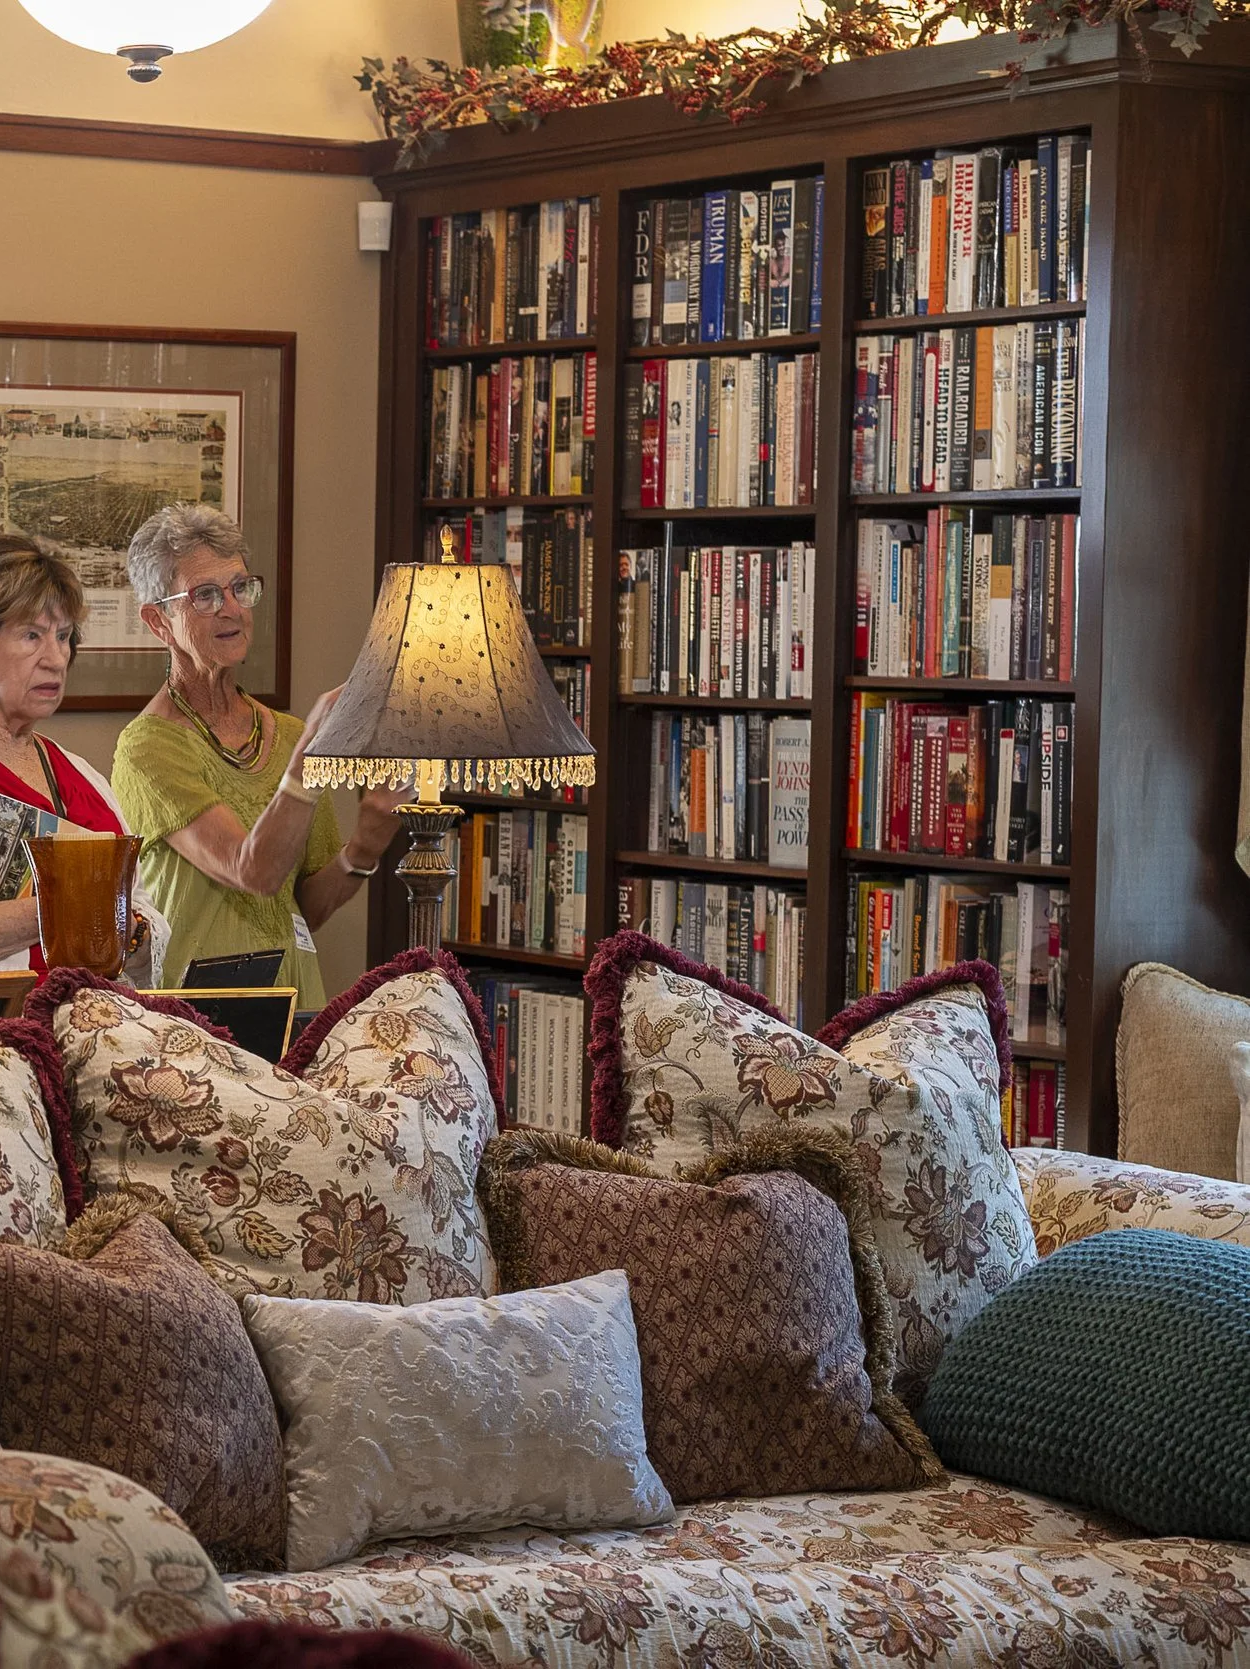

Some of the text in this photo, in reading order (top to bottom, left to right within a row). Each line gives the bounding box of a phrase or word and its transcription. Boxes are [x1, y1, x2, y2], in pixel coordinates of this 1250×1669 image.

[773, 194, 790, 209] JFK
[894, 168, 905, 203] STEVE
[953, 164, 964, 231] BROKER
[962, 159, 974, 258] THE POWER
[709, 196, 726, 264] TRUMAN
[759, 196, 767, 242] BROTHERS
[893, 205, 904, 236] JOBS
[1058, 157, 1068, 282] HARD ROAD WEST
[564, 228, 575, 263] 1776
[689, 240, 701, 324] NO ORDINARY TIME
[586, 357, 597, 431] WASHINGTON
[935, 369, 950, 464] HEAD TO HEAD
[954, 366, 970, 445] RAILROADED
[1035, 364, 1046, 455] AMERICAN ICON
[1050, 379, 1075, 464] RECKONING
[783, 431, 792, 482] REAGAN
[544, 540, 553, 614] JAMES MONROE
[961, 527, 971, 600] JOHN SUTTER
[974, 557, 983, 590] STONE
[982, 555, 990, 590] IRVING
[711, 597, 720, 641] ROULETTE
[722, 555, 732, 656] FIRE AND FURY
[736, 608, 744, 631] BOB
[735, 632, 743, 692] WOODWARD
[774, 738, 801, 747] ROBERT
[851, 716, 857, 725] TO
[850, 748, 856, 757] AN
[1041, 732, 1052, 790] UPSIDE
[794, 796, 807, 805] THE
[930, 791, 935, 800] OF
[500, 818, 511, 859] GRANT
[794, 822, 805, 831] OF
[618, 885, 633, 924] jack
[689, 906, 697, 953] WROUGHT
[867, 896, 876, 972] Go Like Hell
[912, 915, 922, 974] Beyond Spin
[548, 1018, 556, 1067] WOODROW
